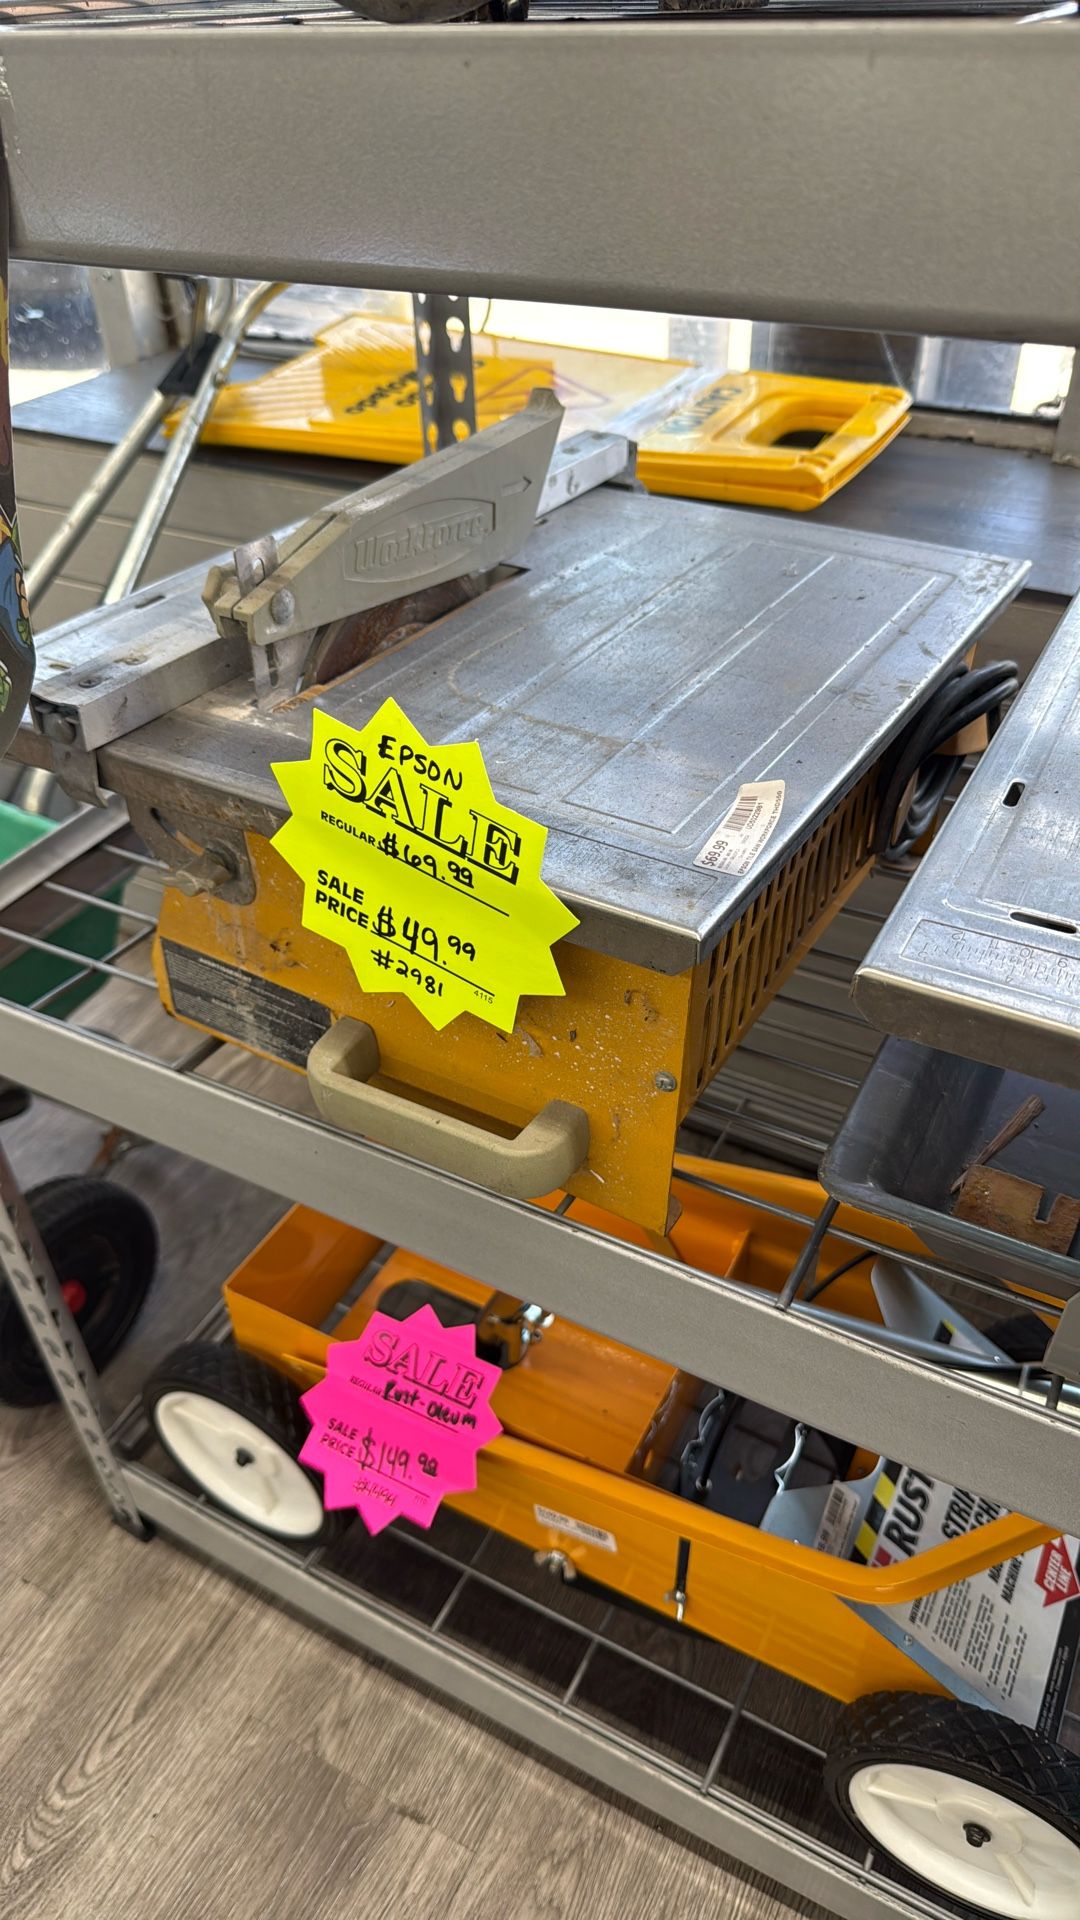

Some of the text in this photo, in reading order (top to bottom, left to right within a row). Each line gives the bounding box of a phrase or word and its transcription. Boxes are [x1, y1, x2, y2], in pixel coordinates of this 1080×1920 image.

[378, 735, 463, 791] EPSON
[323, 738, 522, 886] SALE
[320, 810, 474, 888] REGULAR $69.99
[701, 840, 729, 867] $69.99
[316, 869, 364, 905] SALE
[315, 889, 476, 966] PRICE $49.99
[370, 949, 444, 997] #2981
[473, 989, 494, 1005] 4115
[364, 1329, 485, 1409] SALE
[320, 1434, 356, 1458] PRICE
[328, 1417, 358, 1440] SALE
[1043, 1549, 1063, 1592] CENTER
[1055, 1565, 1072, 1594] LINE
